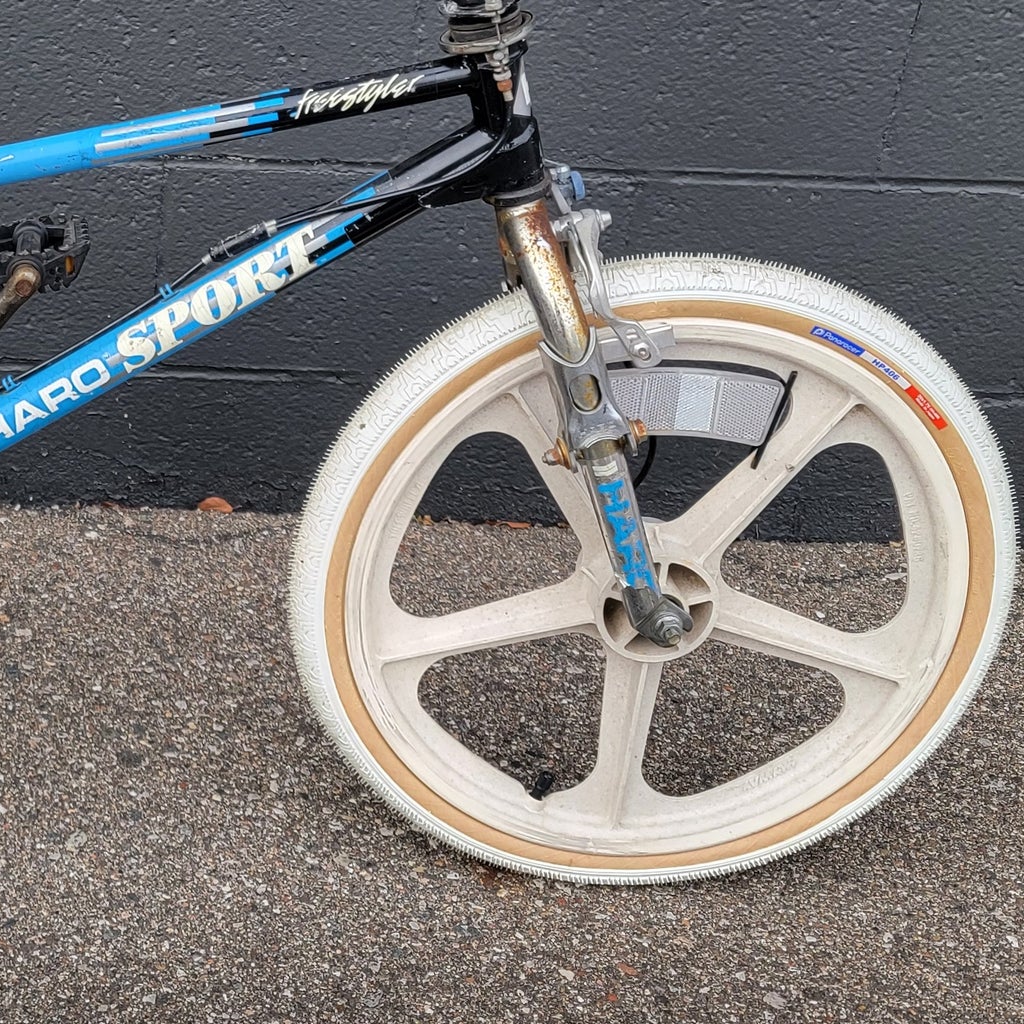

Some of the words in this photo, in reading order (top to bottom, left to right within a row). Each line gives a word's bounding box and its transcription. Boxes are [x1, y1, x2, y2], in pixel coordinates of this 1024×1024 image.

[294, 74, 425, 119] freestyler
[116, 225, 316, 374] SPORT
[872, 358, 900, 382] HP406
